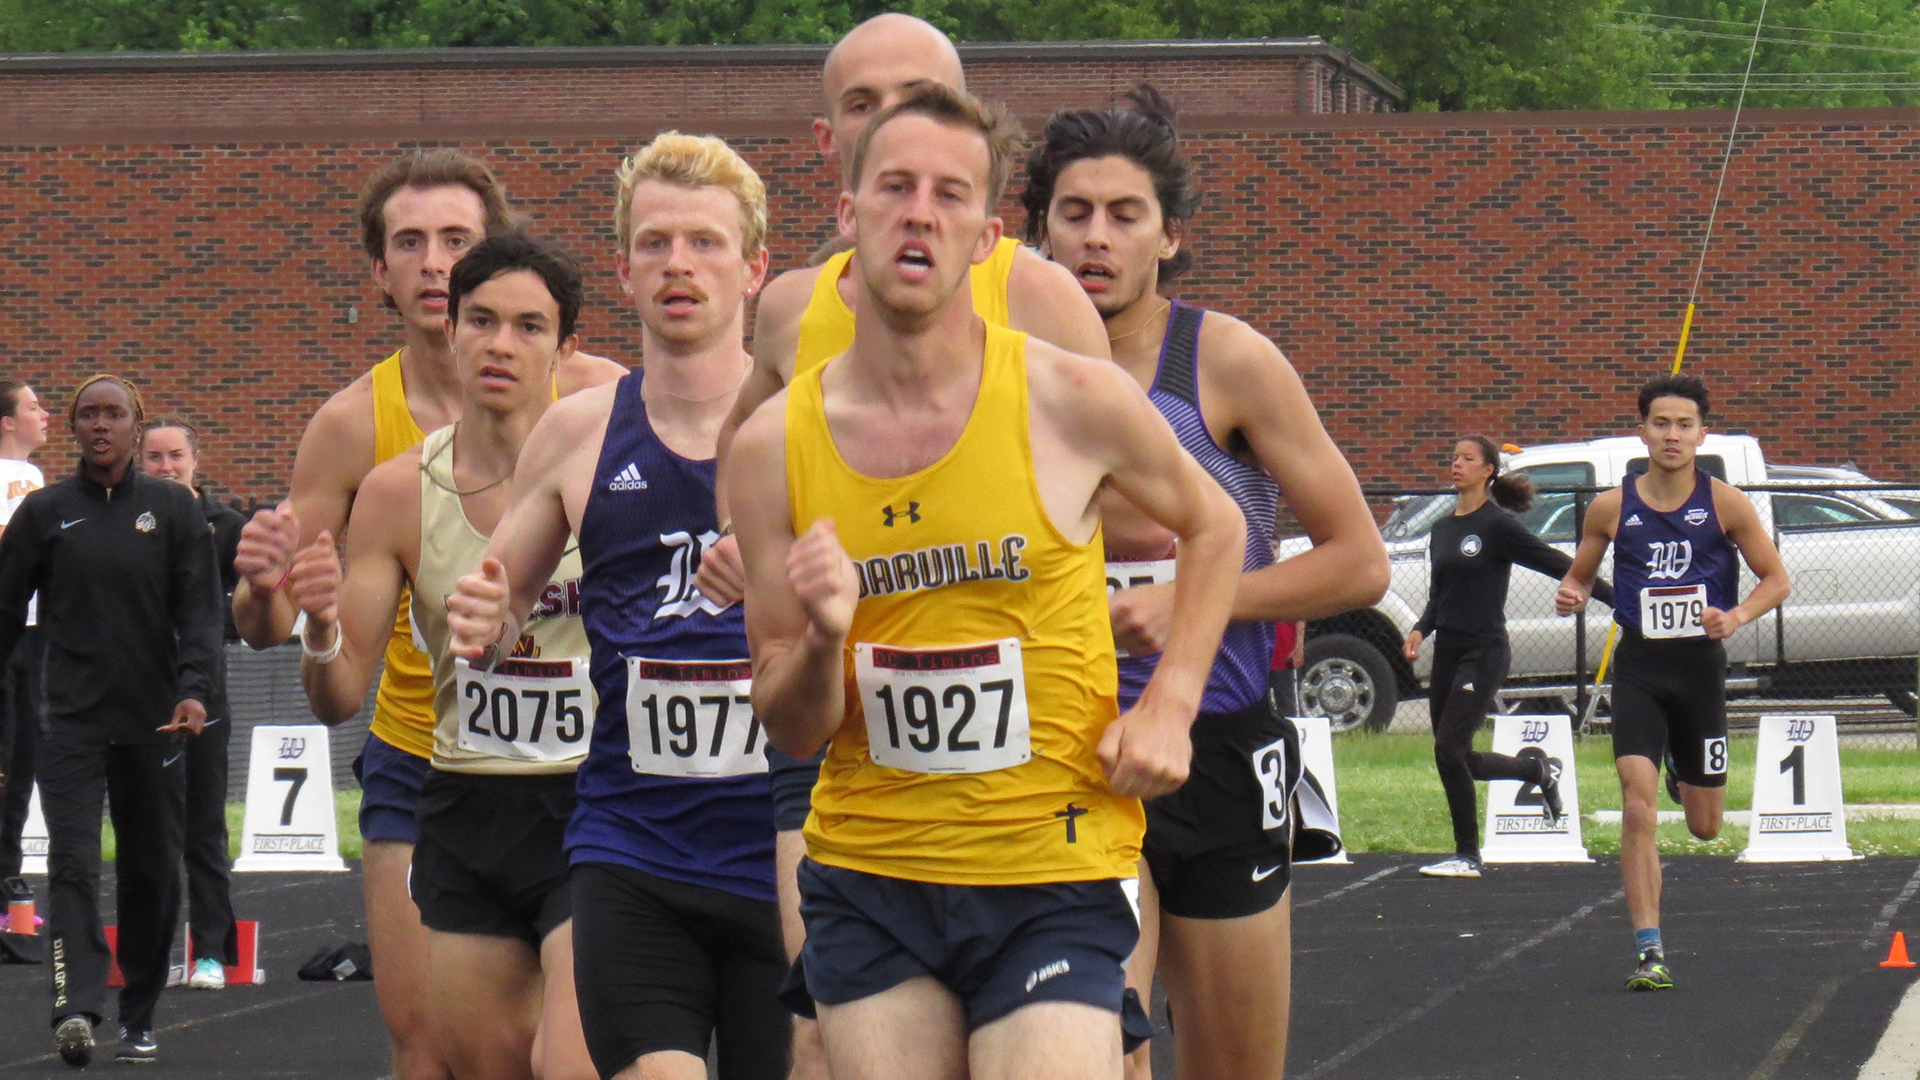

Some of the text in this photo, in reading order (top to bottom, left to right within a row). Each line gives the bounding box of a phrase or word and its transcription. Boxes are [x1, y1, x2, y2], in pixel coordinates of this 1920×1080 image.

[608, 480, 648, 491] adidas
[852, 533, 1032, 600] DARVILLE
[1649, 599, 1704, 630] 1979
[465, 680, 585, 743] 2075
[641, 693, 761, 758] 1977
[875, 678, 1014, 754] 1927
[1260, 748, 1286, 821] 3
[1709, 740, 1725, 772] 8
[1779, 744, 1806, 806] 1
[273, 766, 308, 827] 7
[1495, 818, 1529, 831] FIRST
[1759, 816, 1833, 830] FIRST PLACE
[253, 837, 326, 851] FIRST PLACE
[53, 938, 68, 1008] DRAGONS
